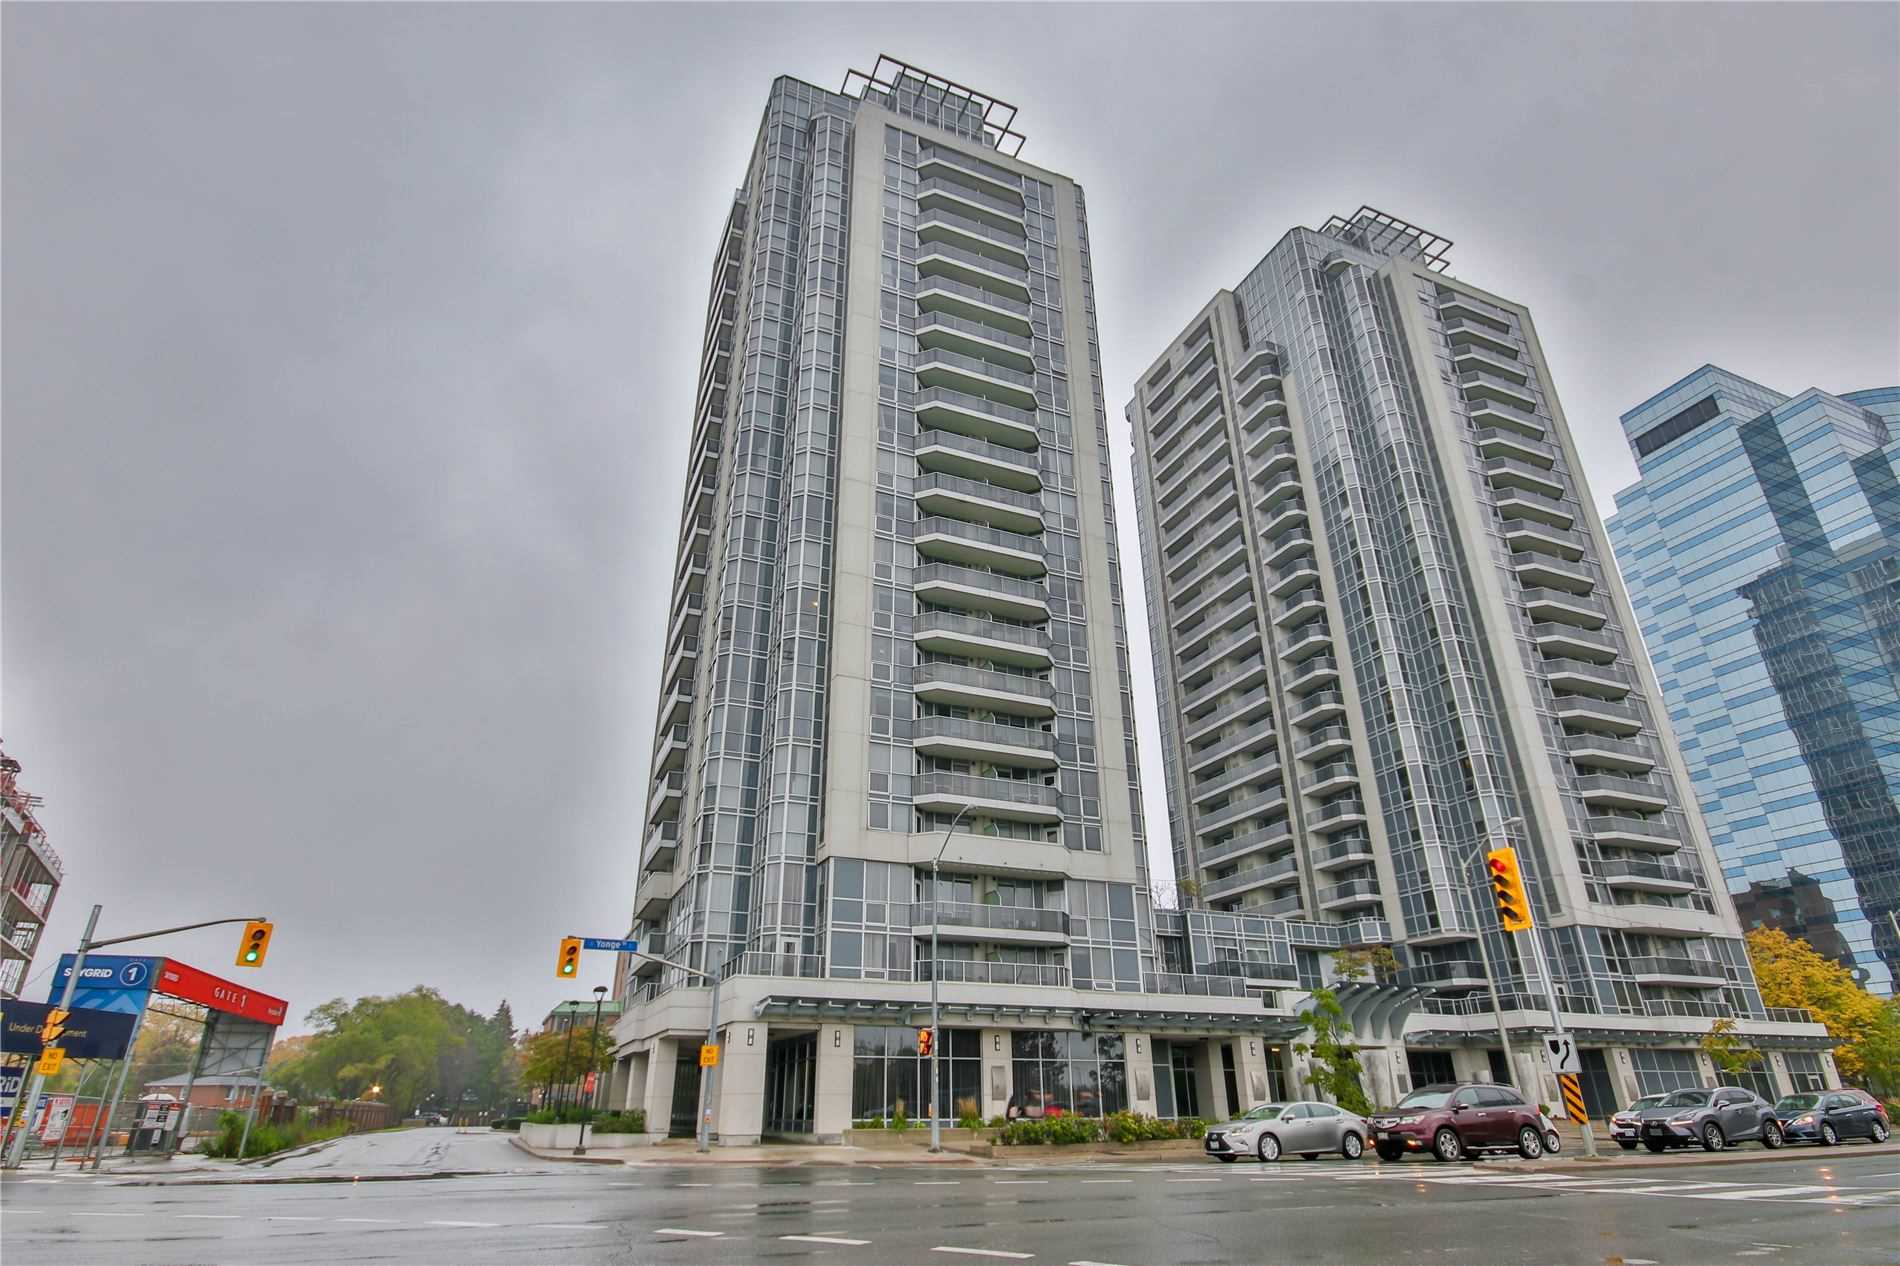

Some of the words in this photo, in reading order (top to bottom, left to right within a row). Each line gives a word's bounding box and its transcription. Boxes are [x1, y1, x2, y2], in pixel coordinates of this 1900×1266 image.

[596, 940, 621, 951] Yonge
[127, 967, 138, 981] 1
[214, 986, 238, 1004] GATE
[240, 994, 248, 1009] 1
[9, 1022, 35, 1033] Under
[48, 1052, 58, 1060] NO
[41, 1062, 57, 1071] EXIT
